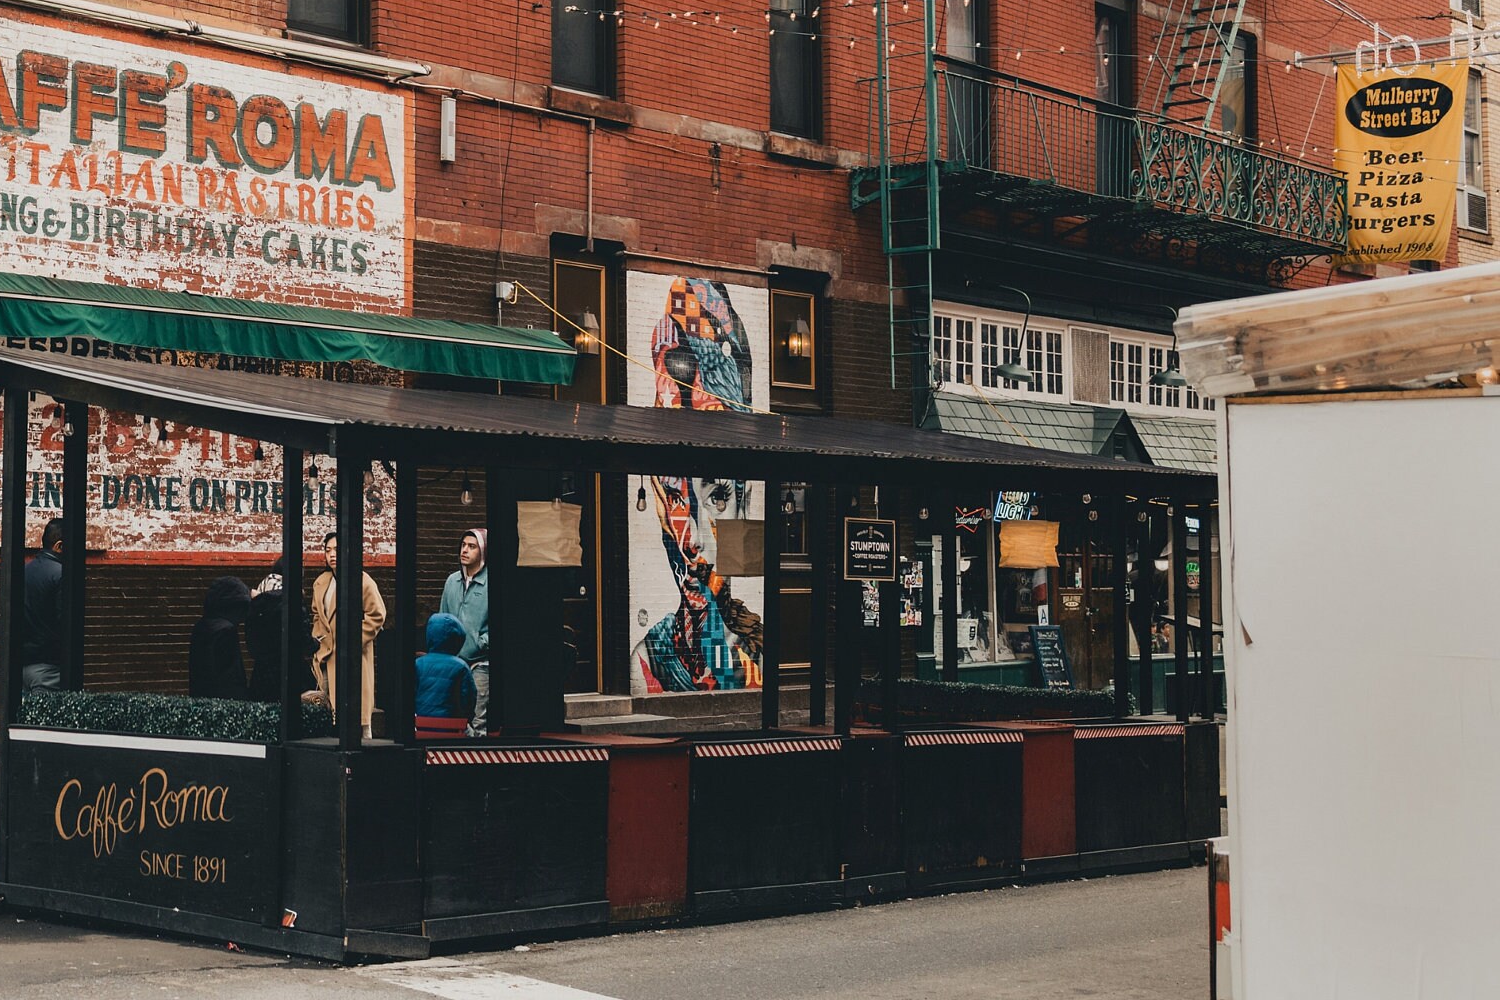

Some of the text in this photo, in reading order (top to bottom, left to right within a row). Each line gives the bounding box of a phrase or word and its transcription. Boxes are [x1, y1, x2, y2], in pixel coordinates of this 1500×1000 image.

[1366, 86, 1440, 107] Mulberry
[1360, 107, 1440, 128] Street Bar
[186, 82, 396, 193] ROMA
[1368, 150, 1423, 165] Beer
[0, 136, 184, 206] ITALIAN
[195, 165, 376, 231] PASTRIES
[1358, 171, 1424, 186] Pizza
[1353, 191, 1422, 208] Pasta
[261, 229, 368, 275] CAKES
[102, 474, 182, 511] DONE
[189, 478, 226, 513] ON
[227, 480, 384, 517] PREISS
[850, 541, 890, 552] STUMPTOWN
[1040, 609, 1047, 623] A
[139, 767, 235, 834] Roma
[140, 850, 227, 883] SINCE 1891
